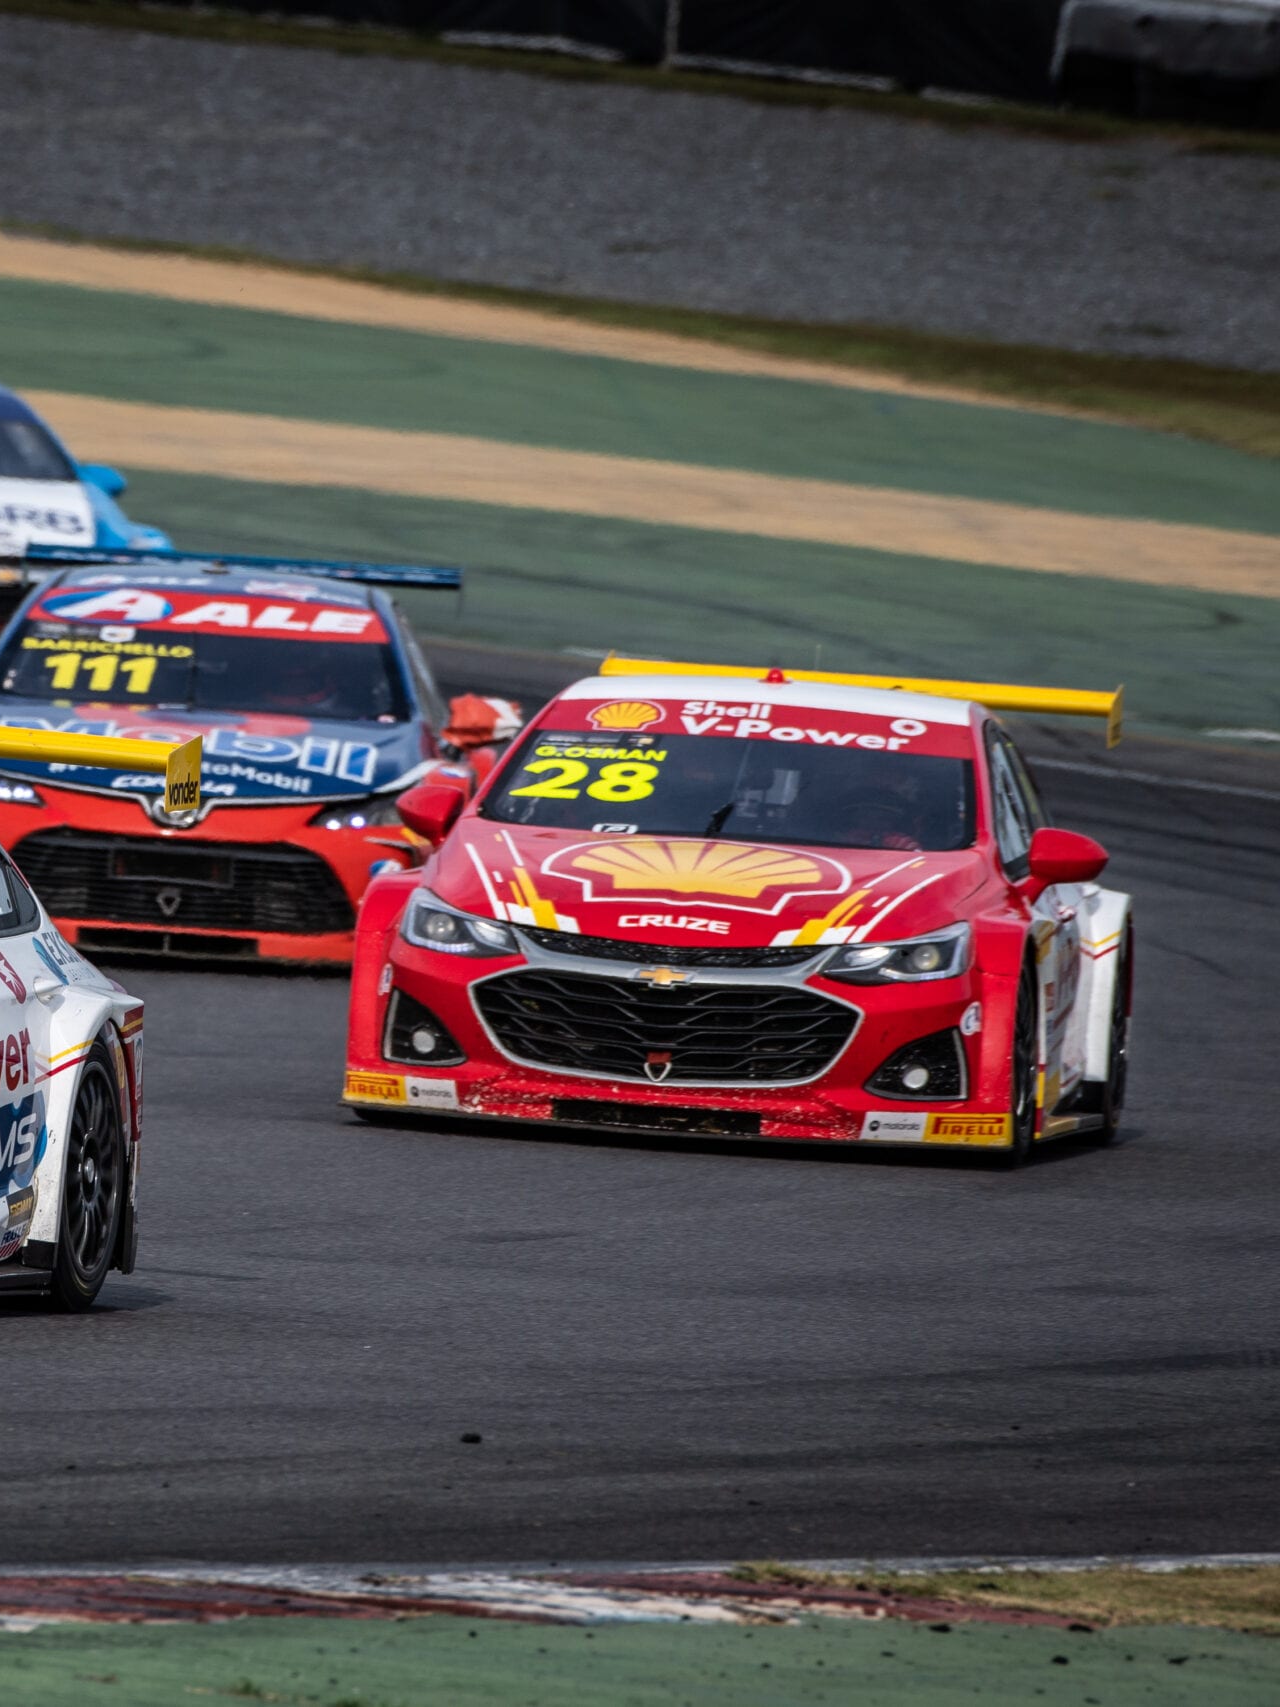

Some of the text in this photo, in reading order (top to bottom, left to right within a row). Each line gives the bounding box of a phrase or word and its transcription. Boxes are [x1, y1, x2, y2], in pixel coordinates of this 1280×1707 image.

[171, 602, 374, 634] ALE
[22, 637, 193, 658] BARRICHELLO
[45, 652, 157, 693] 111
[681, 701, 770, 720] Shell
[680, 716, 909, 751] V-Power
[535, 745, 667, 762] G.OSMAN
[169, 772, 199, 806] vonder
[508, 758, 659, 802] 28
[619, 914, 731, 935] CRUZE
[931, 1117, 1005, 1136] PIRELLI
